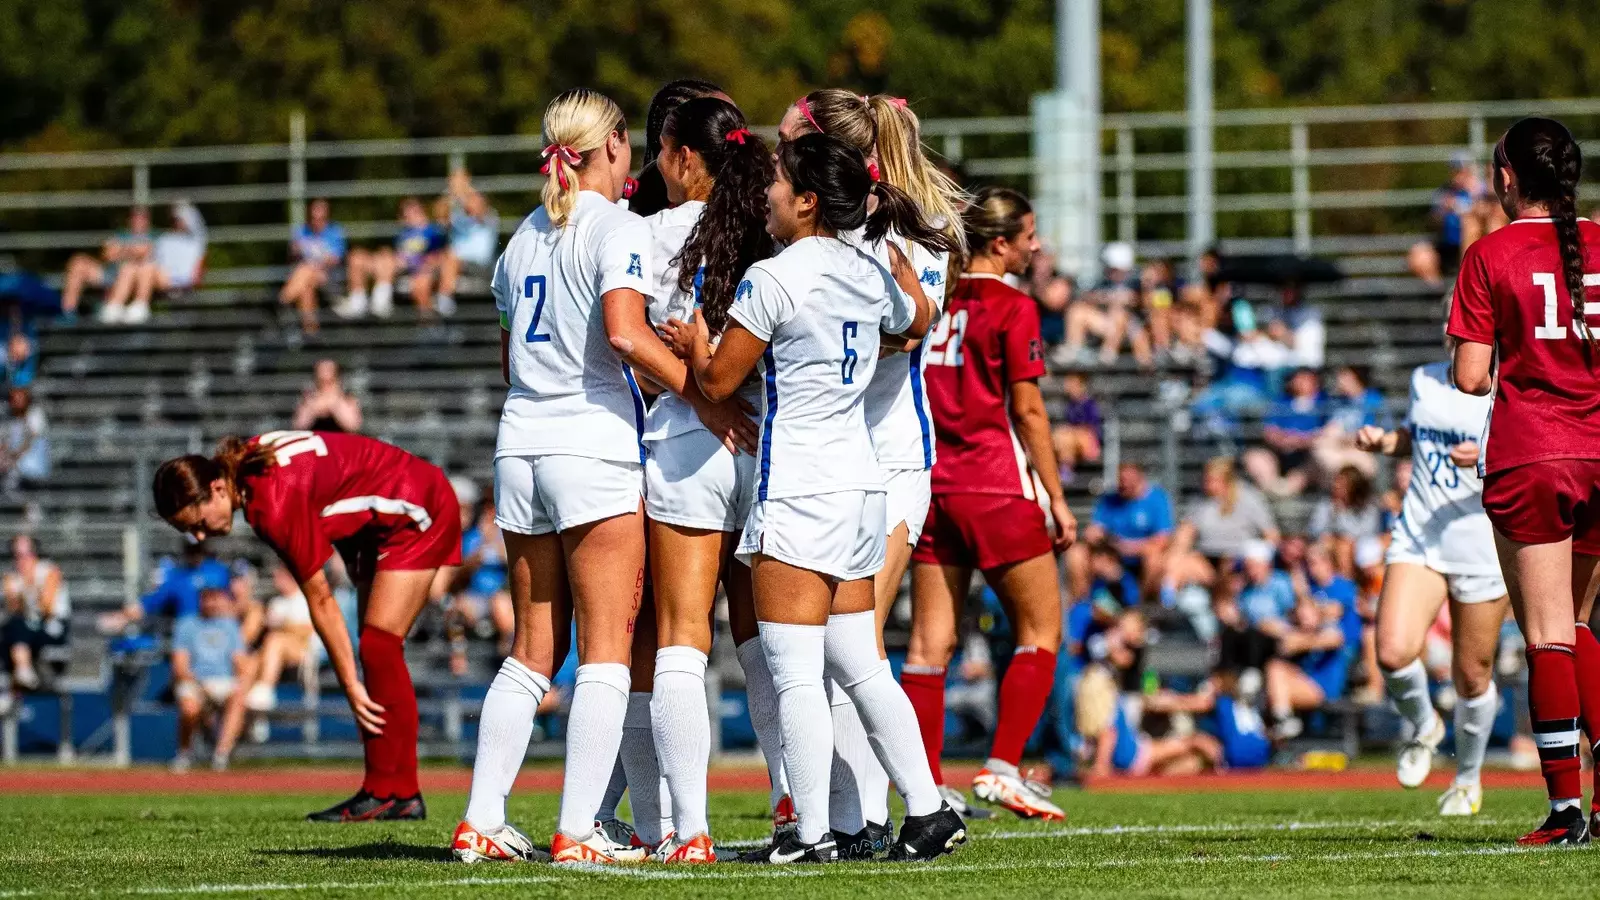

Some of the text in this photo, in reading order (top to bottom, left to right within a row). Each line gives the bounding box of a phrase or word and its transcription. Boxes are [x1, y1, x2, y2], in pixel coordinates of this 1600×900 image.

[524, 274, 551, 343] 2
[924, 309, 969, 367] 22
[841, 321, 859, 385] 6
